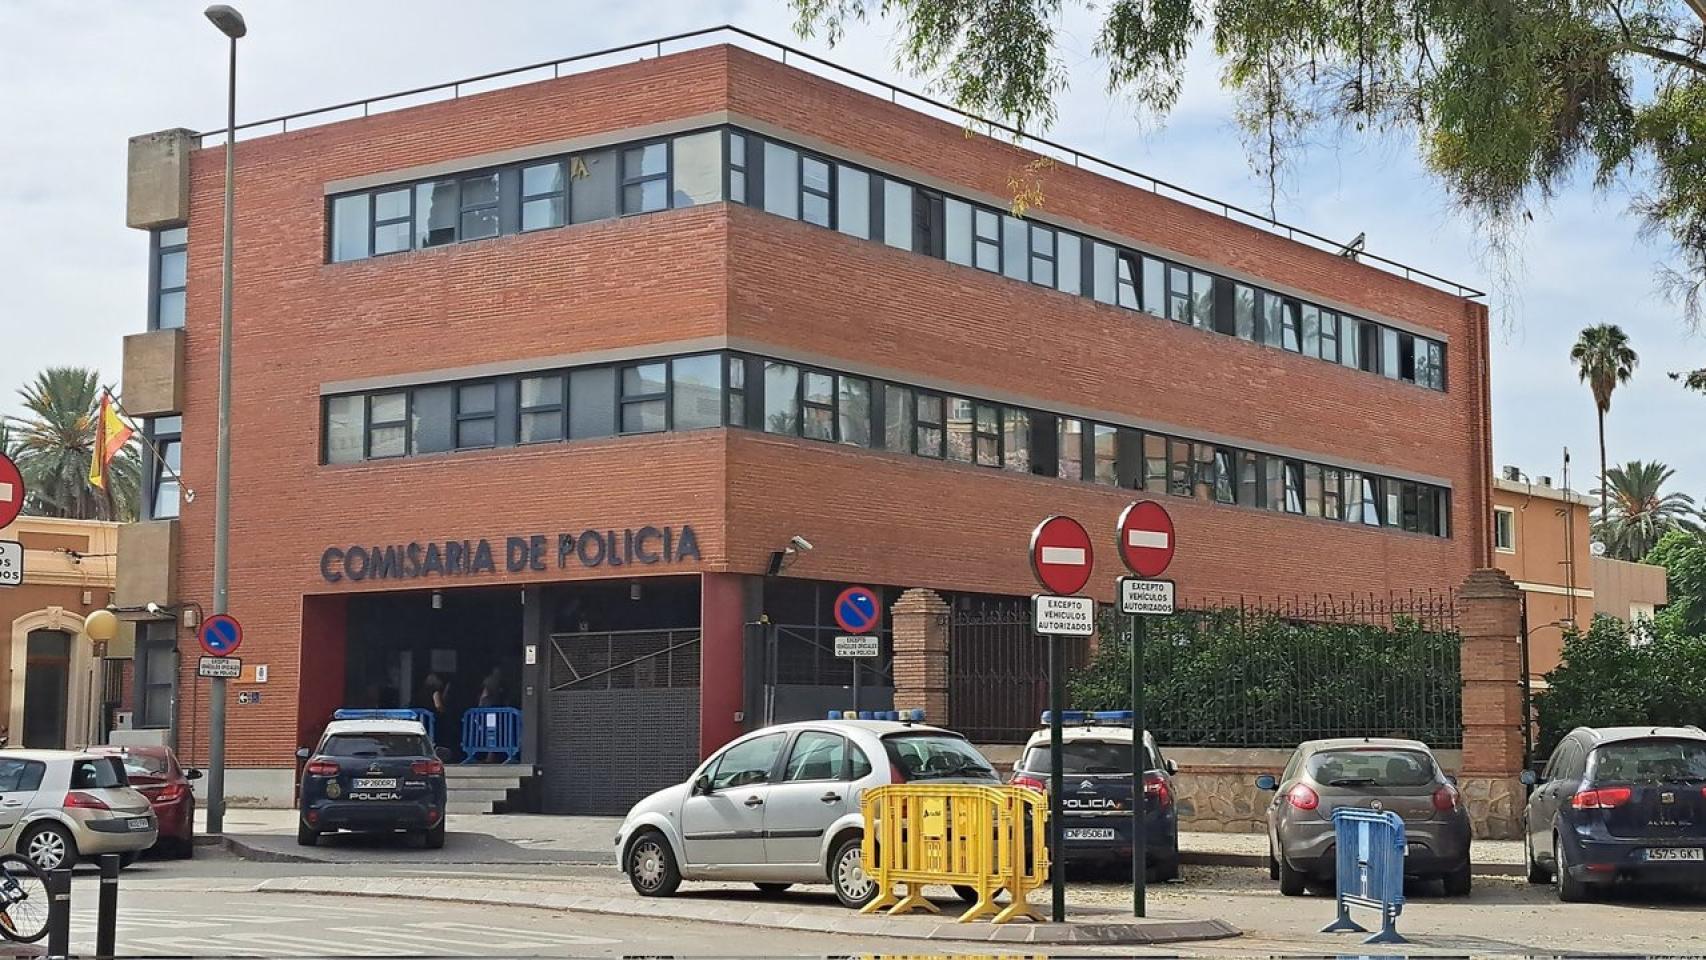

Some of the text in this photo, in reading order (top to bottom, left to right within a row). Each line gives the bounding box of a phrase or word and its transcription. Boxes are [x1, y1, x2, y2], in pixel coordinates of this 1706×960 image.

[320, 525, 700, 582] COMISARIA DE POLICIA
[1131, 582, 1164, 592] EXCEPTO
[1047, 600, 1083, 610] EXCEPTO
[1123, 603, 1172, 613] AUTORIZADOS
[1038, 621, 1092, 631] AUTORIZADOS
[1649, 848, 1700, 859] 4575 GKT
